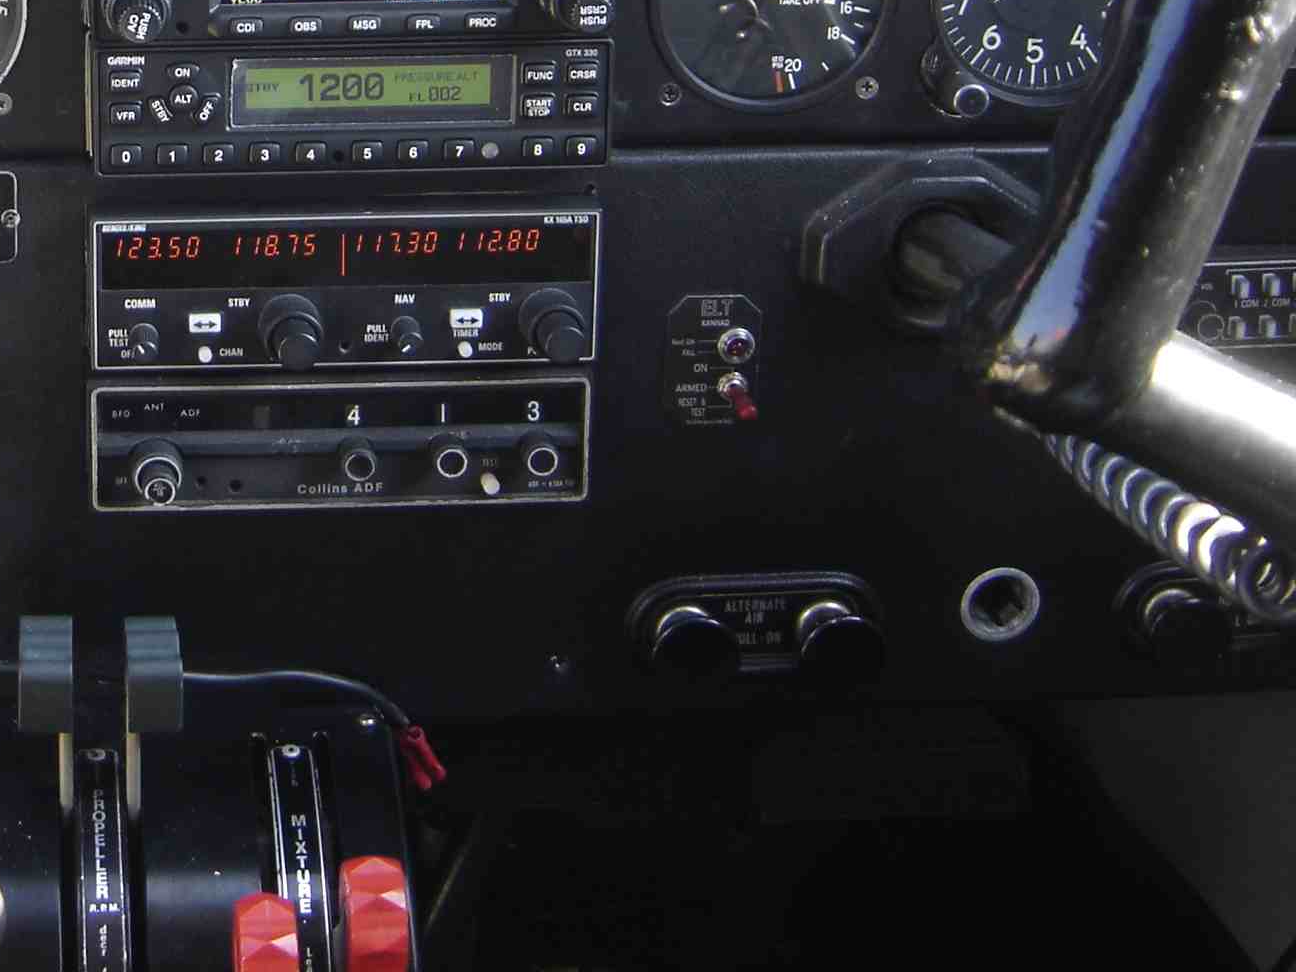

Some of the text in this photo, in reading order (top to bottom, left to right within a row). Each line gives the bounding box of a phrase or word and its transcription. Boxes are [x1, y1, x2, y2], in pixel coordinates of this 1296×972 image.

[295, 22, 317, 31] OBS
[353, 20, 376, 29] MSG
[416, 20, 433, 28] FPL
[469, 18, 496, 27] PROC
[237, 23, 255, 32] CDI
[108, 56, 144, 65] GARMIN
[175, 68, 190, 77] ON
[528, 71, 553, 80] FUNC
[570, 70, 596, 79] CRSR
[112, 79, 139, 87] IDENT
[300, 73, 384, 103] 1200
[175, 94, 192, 103] ALT
[527, 100, 551, 108] START
[574, 103, 592, 111] CLR
[116, 112, 135, 120] VFR
[200, 103, 214, 120] OFF
[528, 108, 550, 116] STOP
[357, 230, 540, 253] 117.30 112.80
[116, 235, 316, 259] 123.50 118.75
[395, 294, 415, 303] NAV
[489, 293, 510, 302] STBY
[125, 299, 156, 308] COMM
[228, 298, 250, 307] STBY
[701, 299, 733, 316] ELT
[478, 343, 502, 351] MODE
[297, 483, 383, 495] Collins ADF
[291, 815, 312, 913] MIXTURE
